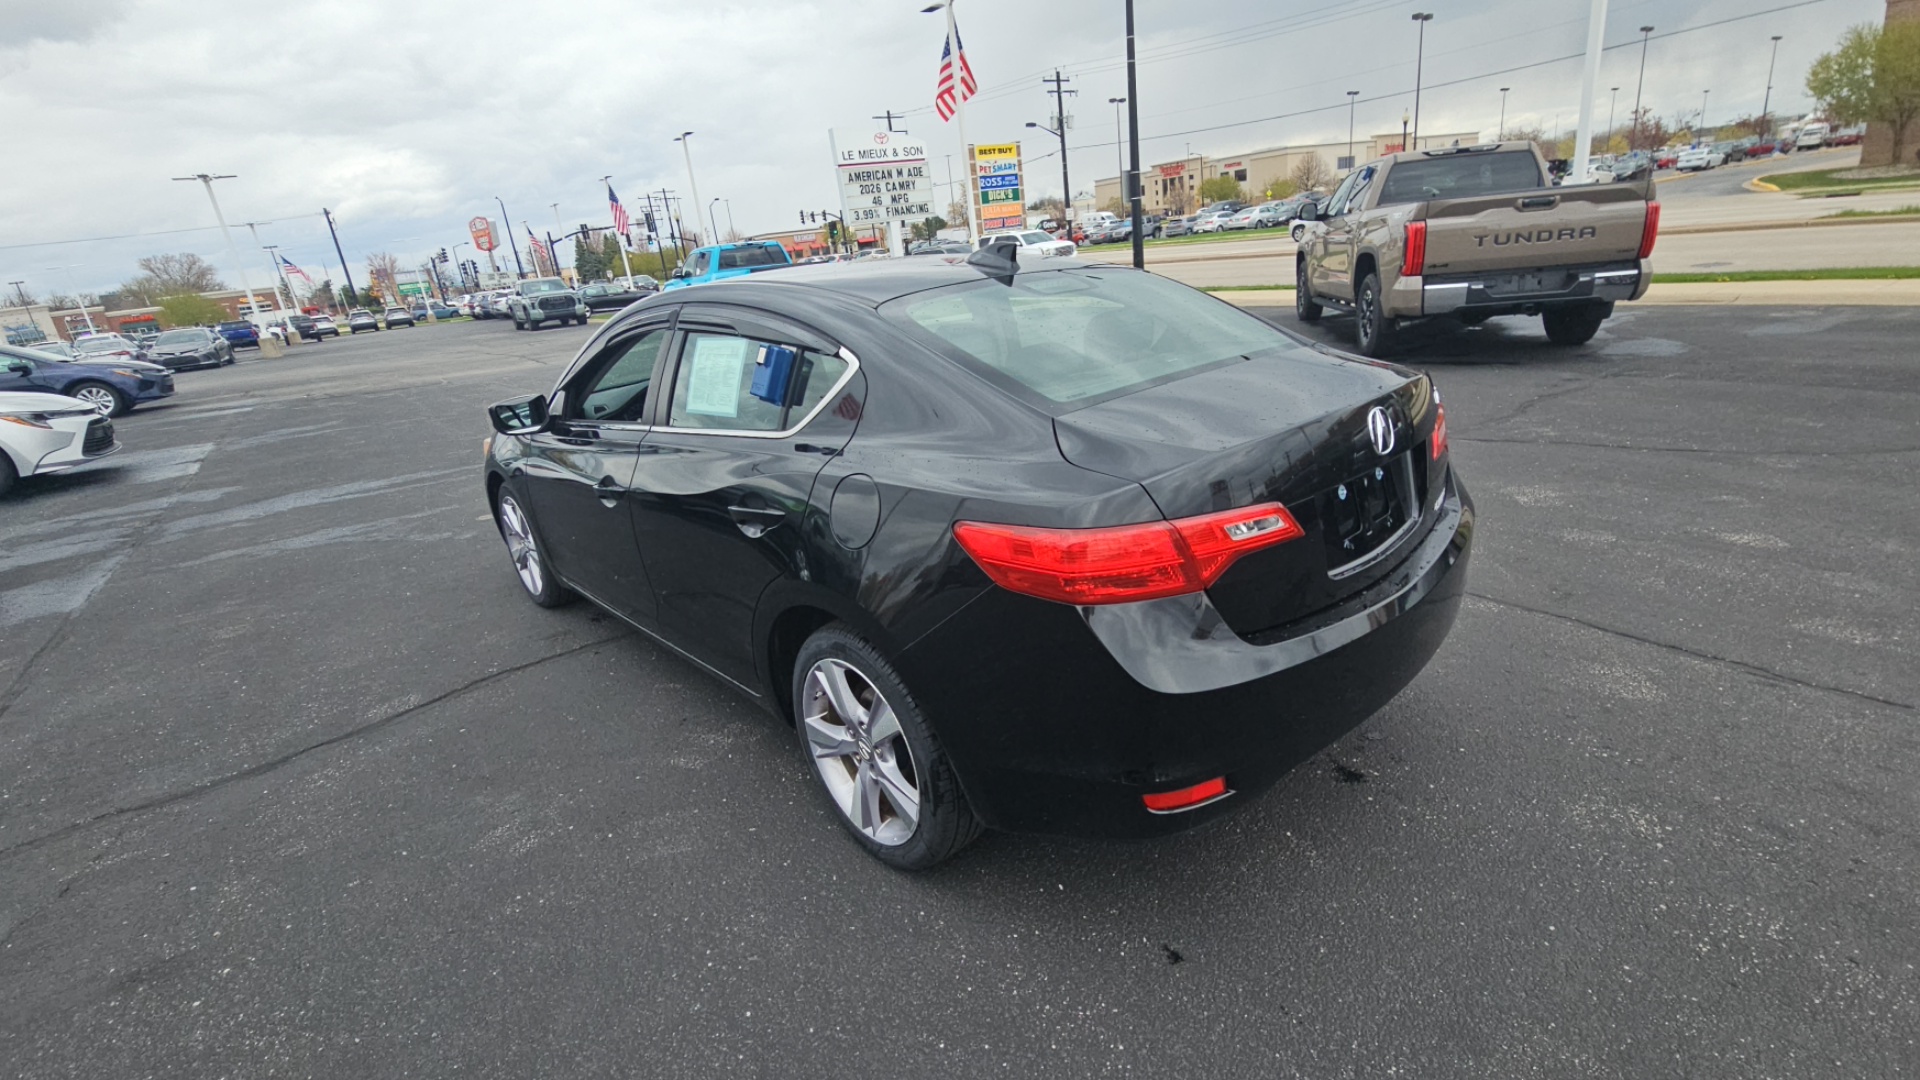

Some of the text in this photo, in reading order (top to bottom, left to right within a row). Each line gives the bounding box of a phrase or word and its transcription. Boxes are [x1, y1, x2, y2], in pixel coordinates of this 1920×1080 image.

[842, 146, 923, 161] LE MIEUX & SON
[848, 169, 893, 183] AMERICAN
[860, 180, 916, 195] 2026 CAMRY
[988, 189, 1013, 200] DICK'S
[872, 193, 909, 206] 46 MPG
[854, 203, 929, 221] 3.99% FINANCING
[1473, 226, 1597, 247] TUNDRA
